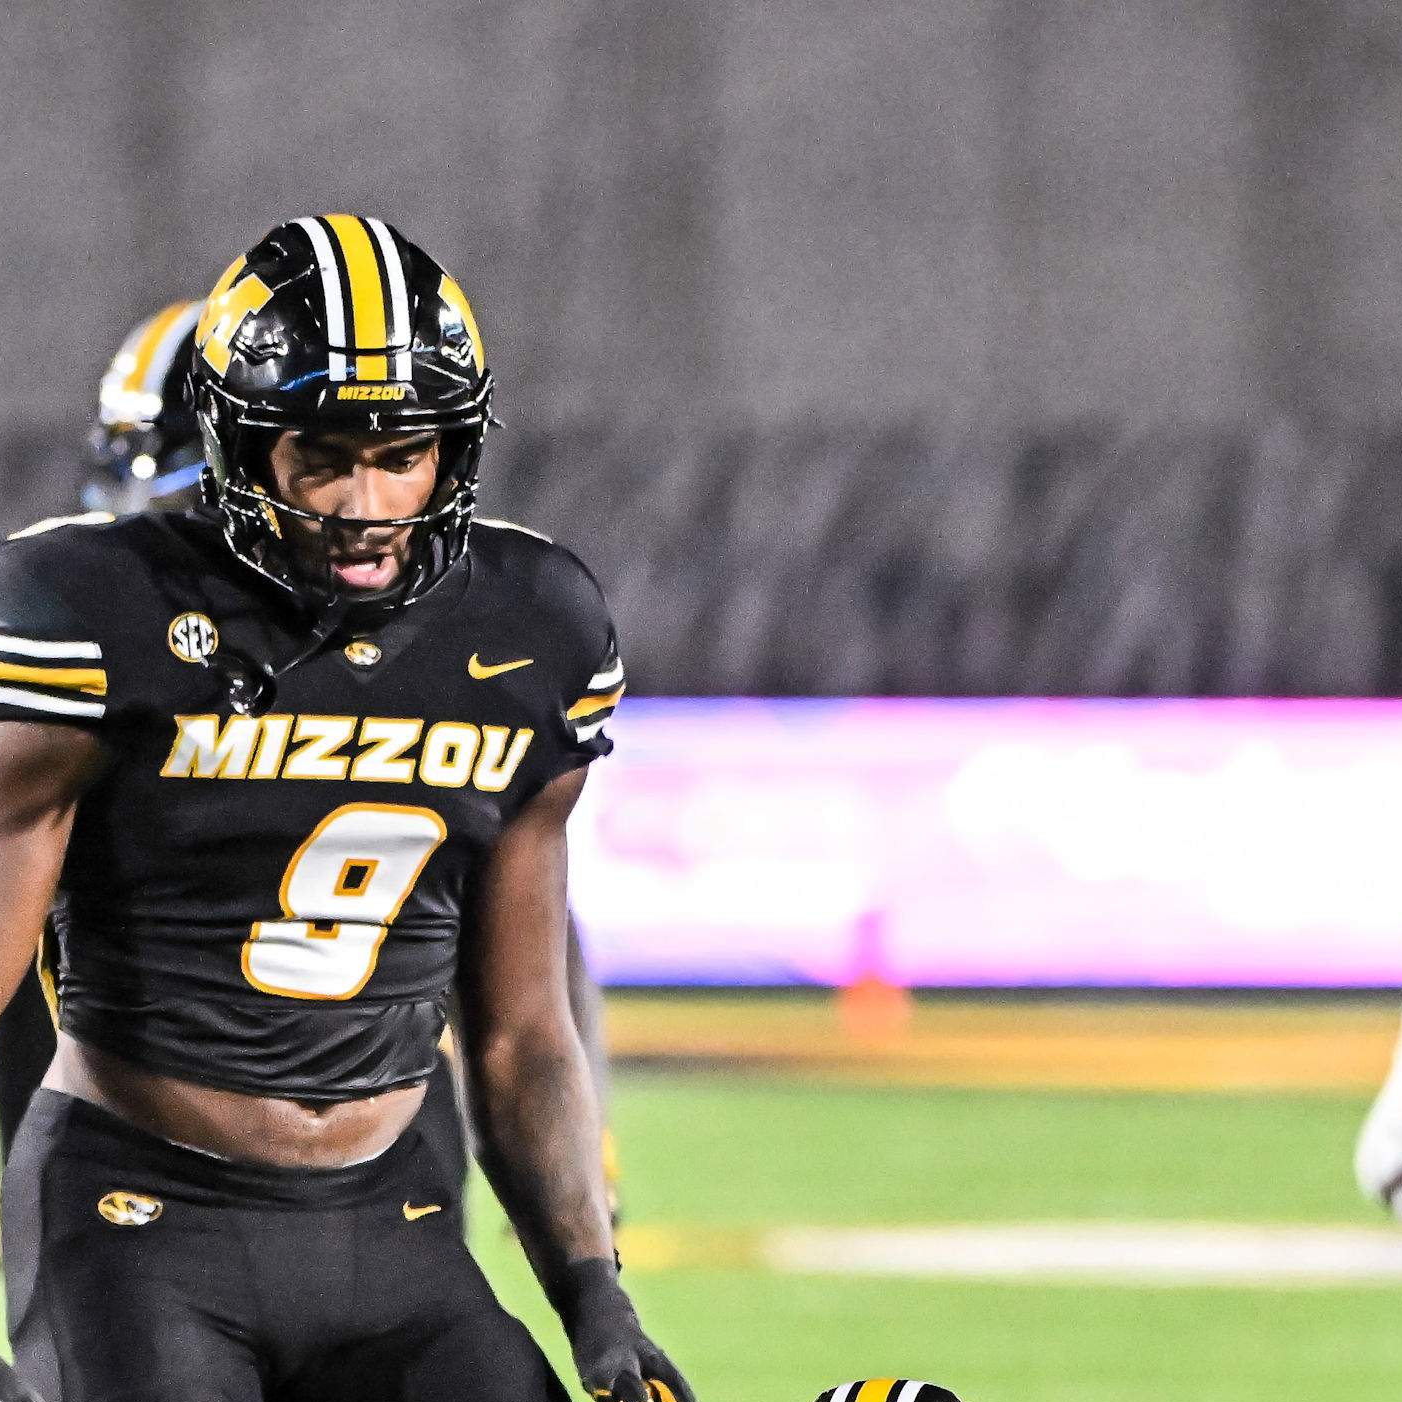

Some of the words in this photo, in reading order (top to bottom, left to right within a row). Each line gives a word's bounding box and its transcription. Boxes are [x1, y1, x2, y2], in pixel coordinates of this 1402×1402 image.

[337, 386, 406, 401] MIZZOU
[172, 615, 215, 659] SEC
[159, 714, 534, 792] MIZZOU
[241, 802, 447, 1000] 9
